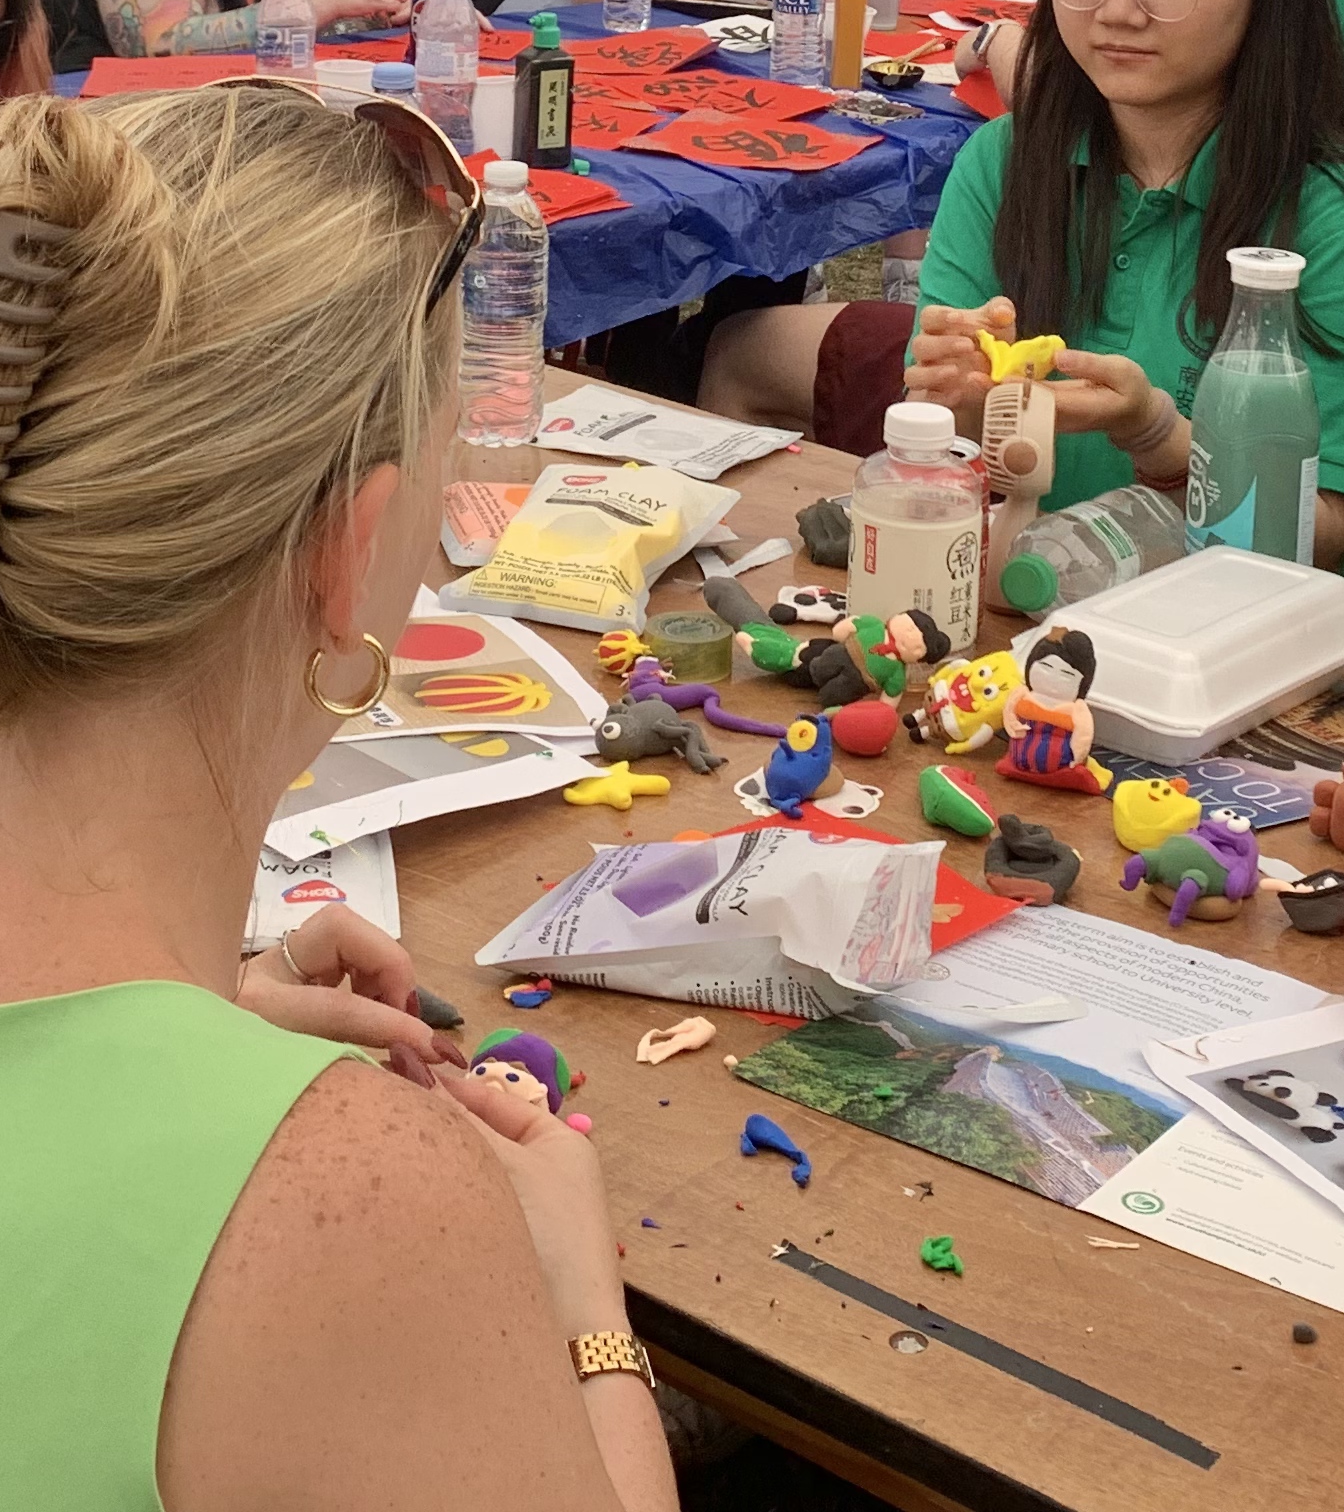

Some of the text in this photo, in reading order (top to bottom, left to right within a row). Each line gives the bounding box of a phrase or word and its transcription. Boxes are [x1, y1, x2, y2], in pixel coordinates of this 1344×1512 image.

[555, 487, 667, 512] FOAM CLAY
[259, 859, 332, 879] FOAM
[291, 886, 339, 899] BOHS
[1013, 932, 1254, 1020] primary school to University level.
[1038, 911, 1264, 988] long term aim is to and
[1052, 931, 1068, 944] all
[1067, 937, 1119, 961] aspects
[1120, 956, 1136, 967] of
[1136, 962, 1196, 987] modern
[1056, 925, 1271, 1004] the provision of opportunities
